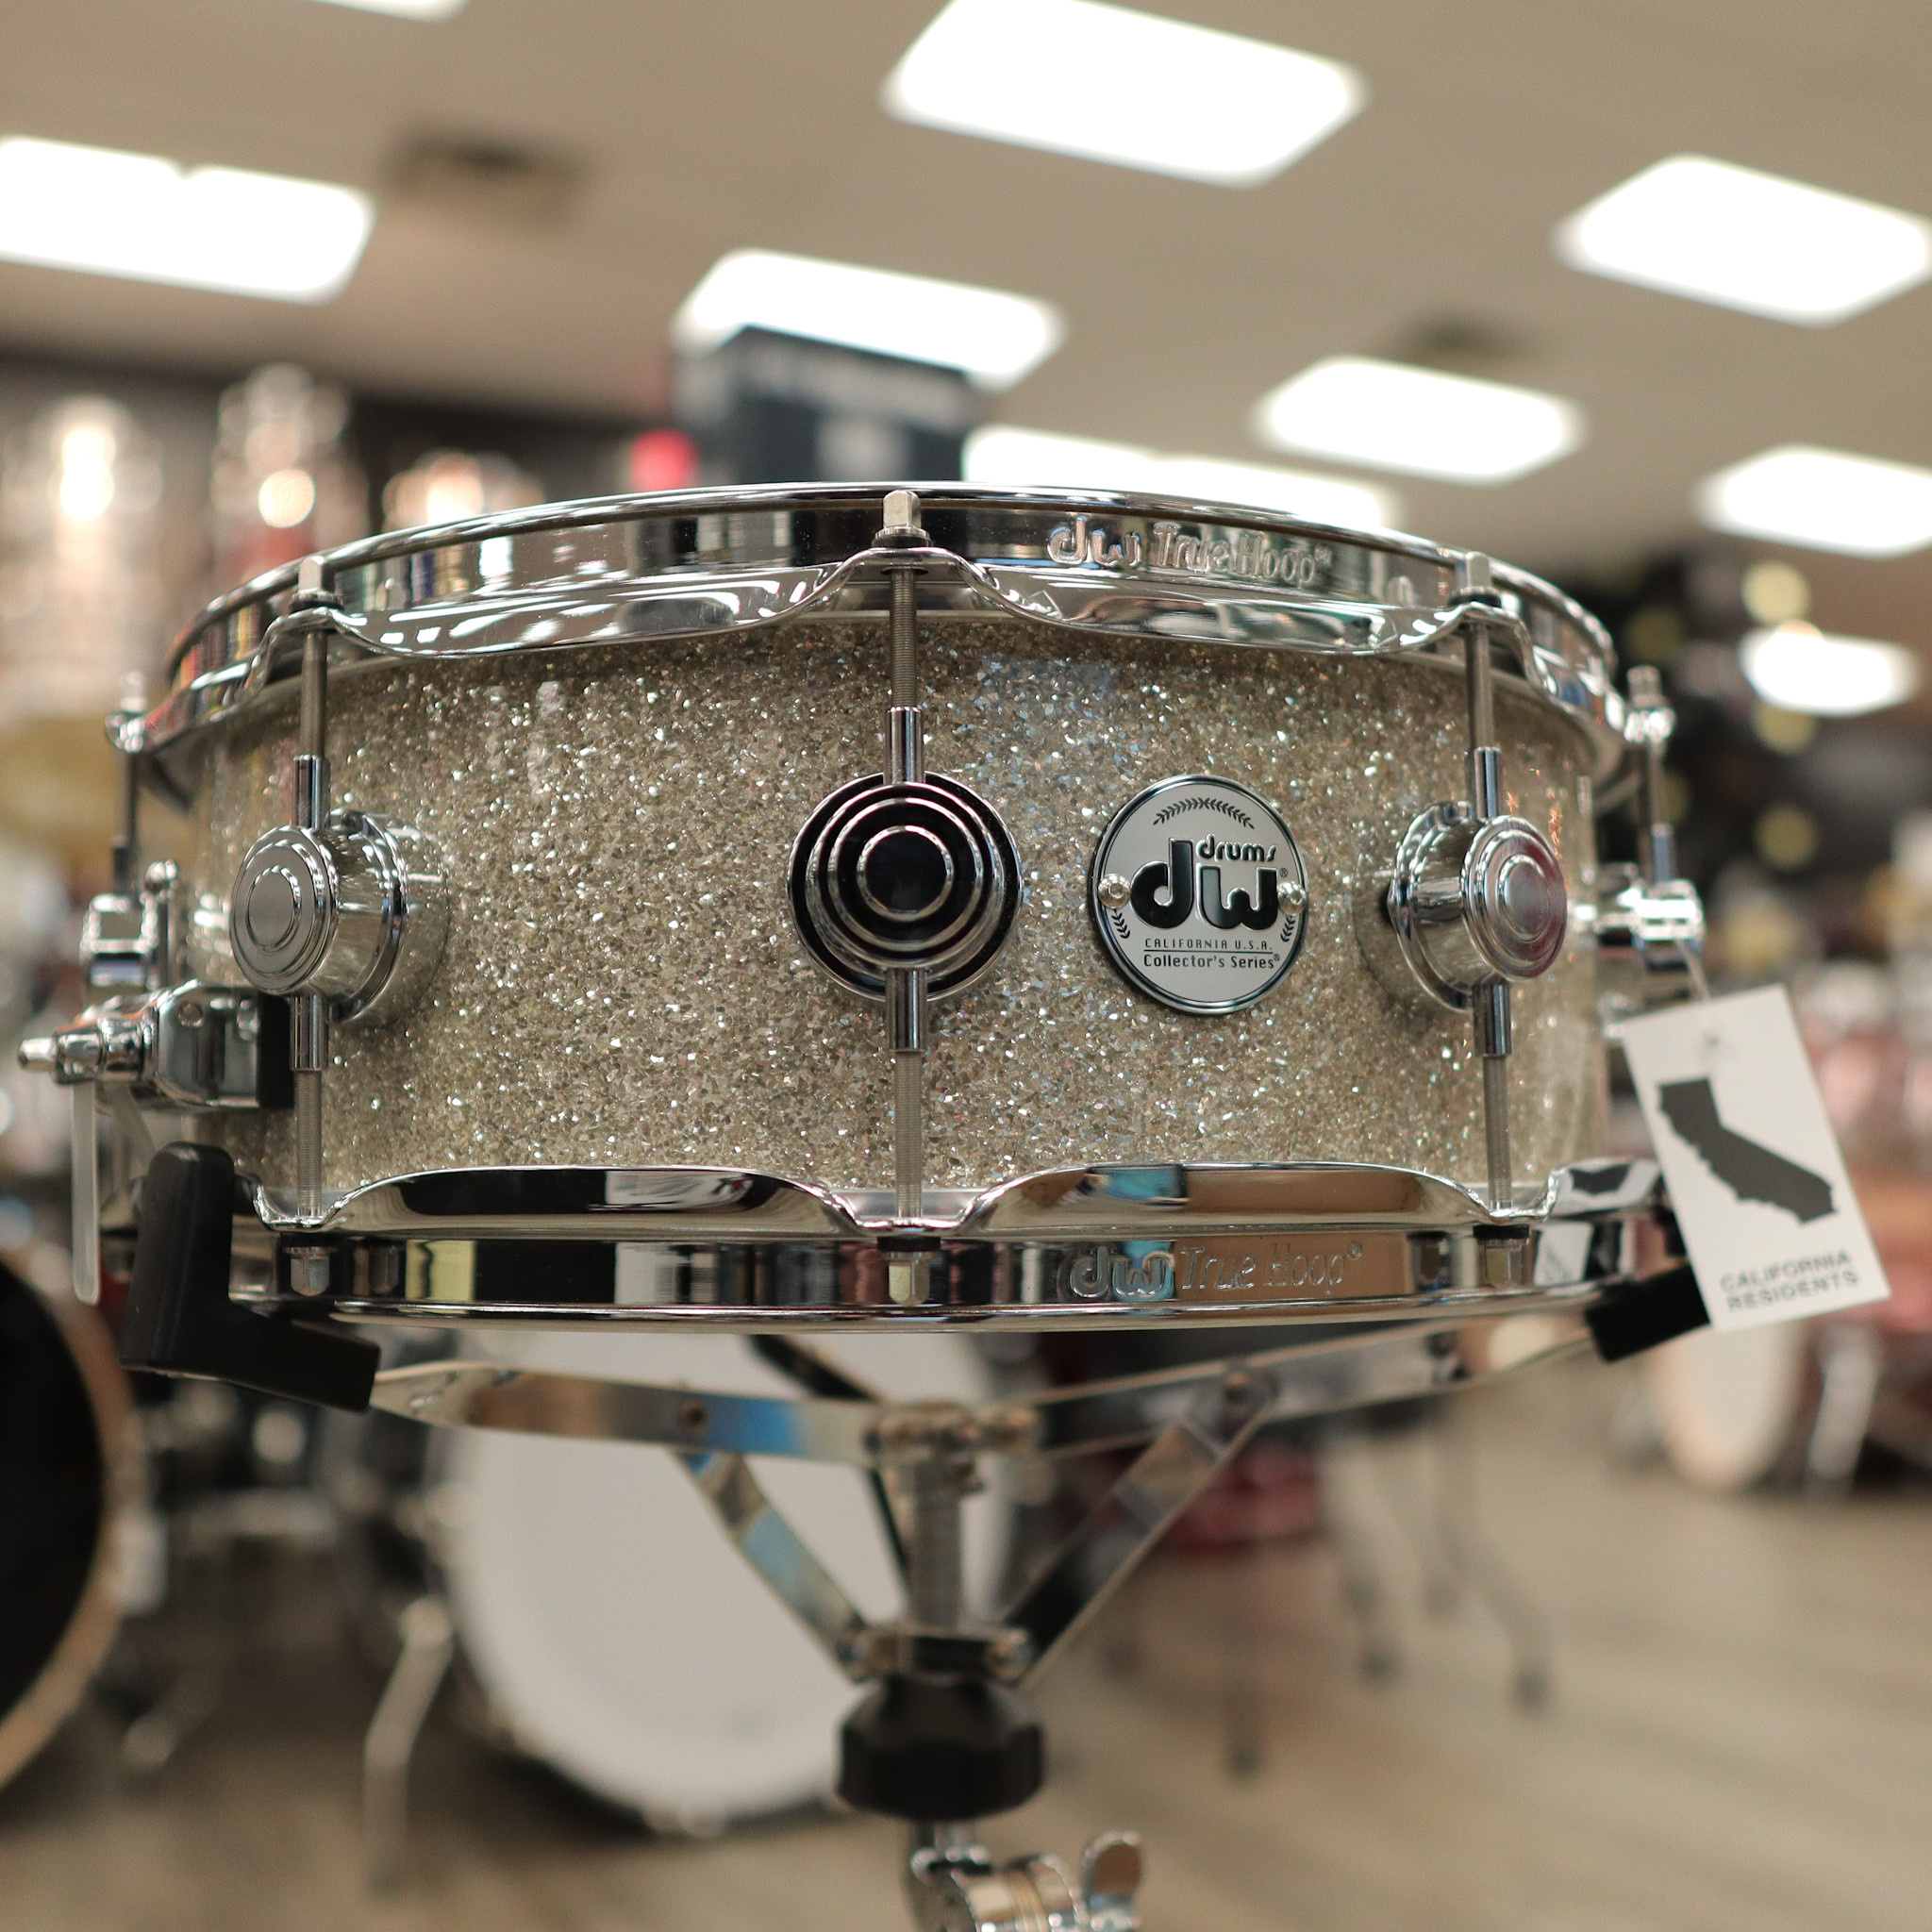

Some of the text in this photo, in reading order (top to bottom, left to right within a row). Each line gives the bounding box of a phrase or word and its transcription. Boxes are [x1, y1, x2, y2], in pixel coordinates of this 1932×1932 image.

[1047, 515, 1141, 566] dw
[1153, 522, 1229, 574] True
[1195, 833, 1277, 862] drums
[1131, 837, 1279, 931] dw
[1143, 954, 1274, 969] Collector's Series
[1144, 938, 1274, 951] CALIFORNIA U.S.A.
[1069, 1245, 1167, 1299] dw
[1179, 1246, 1257, 1291] True
[1720, 1249, 1851, 1292] CALIFORNIA
[1727, 1269, 1858, 1310] RESIDENTS
